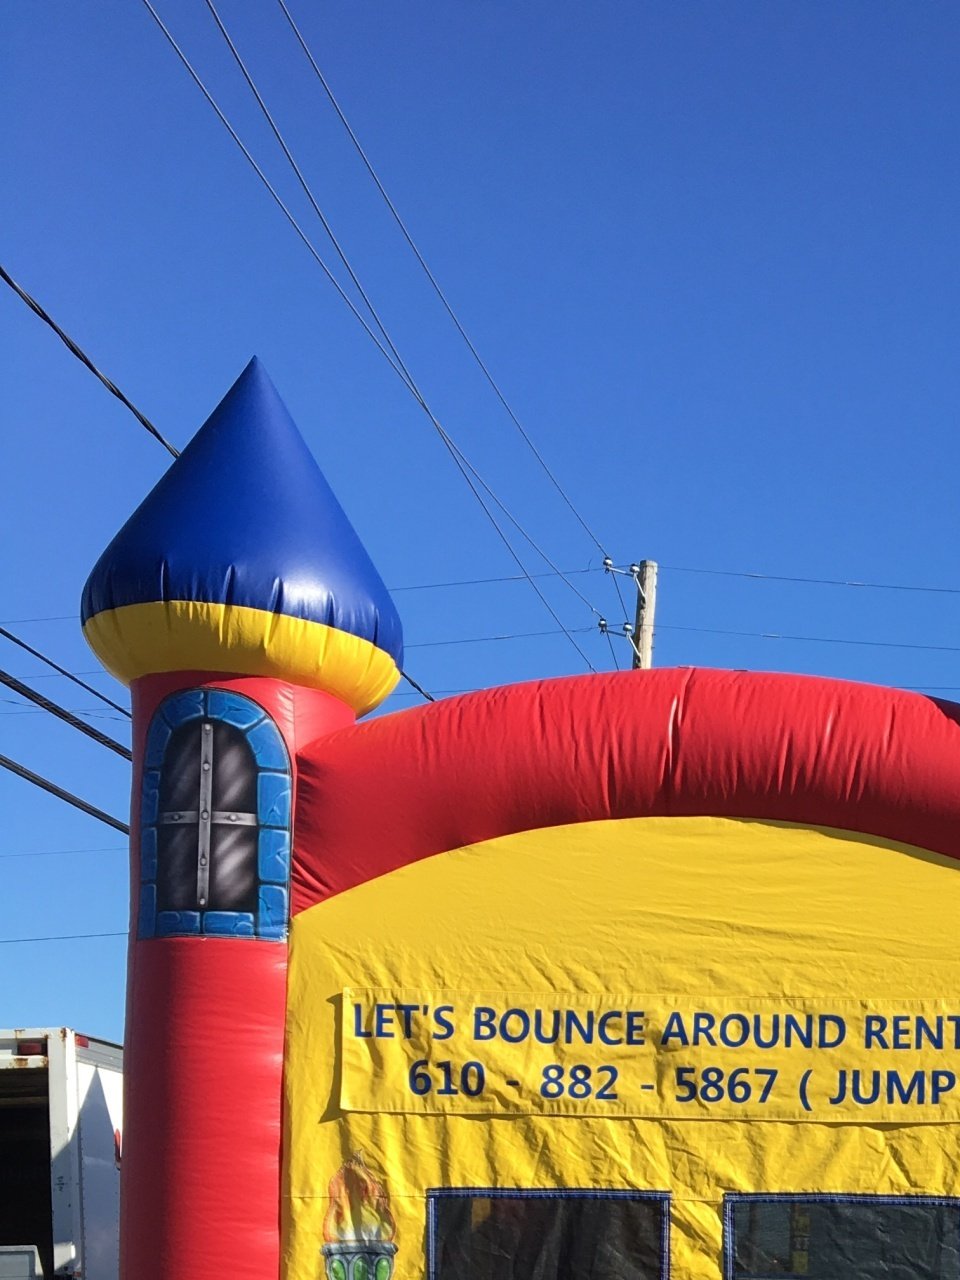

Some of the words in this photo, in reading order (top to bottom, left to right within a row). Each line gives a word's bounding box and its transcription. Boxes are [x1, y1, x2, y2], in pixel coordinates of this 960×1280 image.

[354, 1003, 455, 1040] LET'S
[473, 1007, 645, 1046] BOUNCE
[660, 1011, 847, 1048] AROUND
[408, 1059, 485, 1097] 610
[505, 1079, 520, 1087] -
[540, 1064, 618, 1100] 882
[641, 1083, 655, 1091] -
[675, 1067, 778, 1104] 5867
[829, 1069, 956, 1105] JUMP
